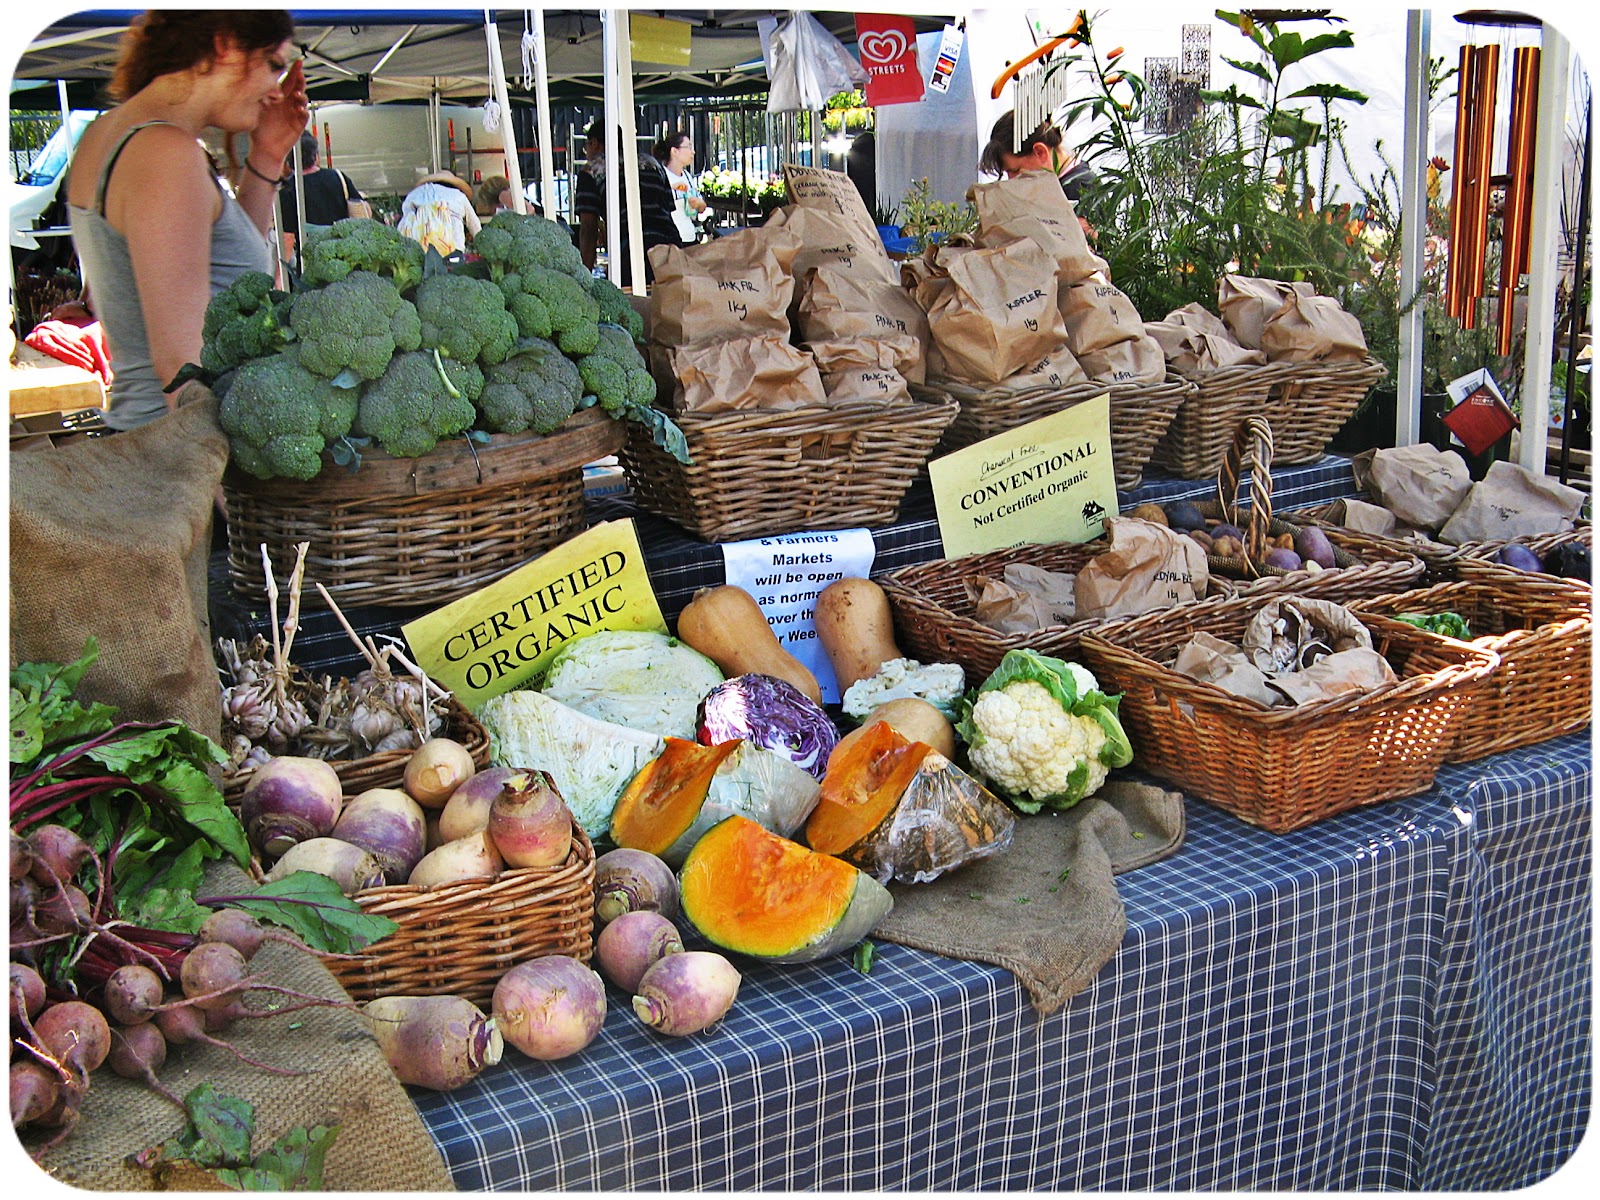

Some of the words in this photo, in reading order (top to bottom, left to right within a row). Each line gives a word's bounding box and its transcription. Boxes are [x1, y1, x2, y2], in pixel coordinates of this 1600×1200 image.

[944, 45, 958, 56] VISA
[868, 64, 905, 76] STREETS
[741, 280, 760, 293] FIR
[1005, 289, 1048, 311] KIPFLER
[727, 299, 748, 321] 1kg
[1023, 318, 1038, 332] 1kg
[960, 441, 1097, 510] CONVENTIONAL
[973, 511, 994, 528] Not
[997, 488, 1045, 518] Certified
[1047, 469, 1089, 496] Organic
[776, 534, 839, 545] Farmers
[773, 552, 833, 566] Markets
[755, 574, 782, 586] will
[786, 572, 803, 583] be
[807, 572, 843, 583] open
[758, 595, 775, 606] as
[780, 591, 822, 603] norma
[443, 551, 626, 662] CERTIFIED
[768, 613, 797, 625] over
[801, 609, 813, 620] th
[465, 585, 626, 689] ORGANIC
